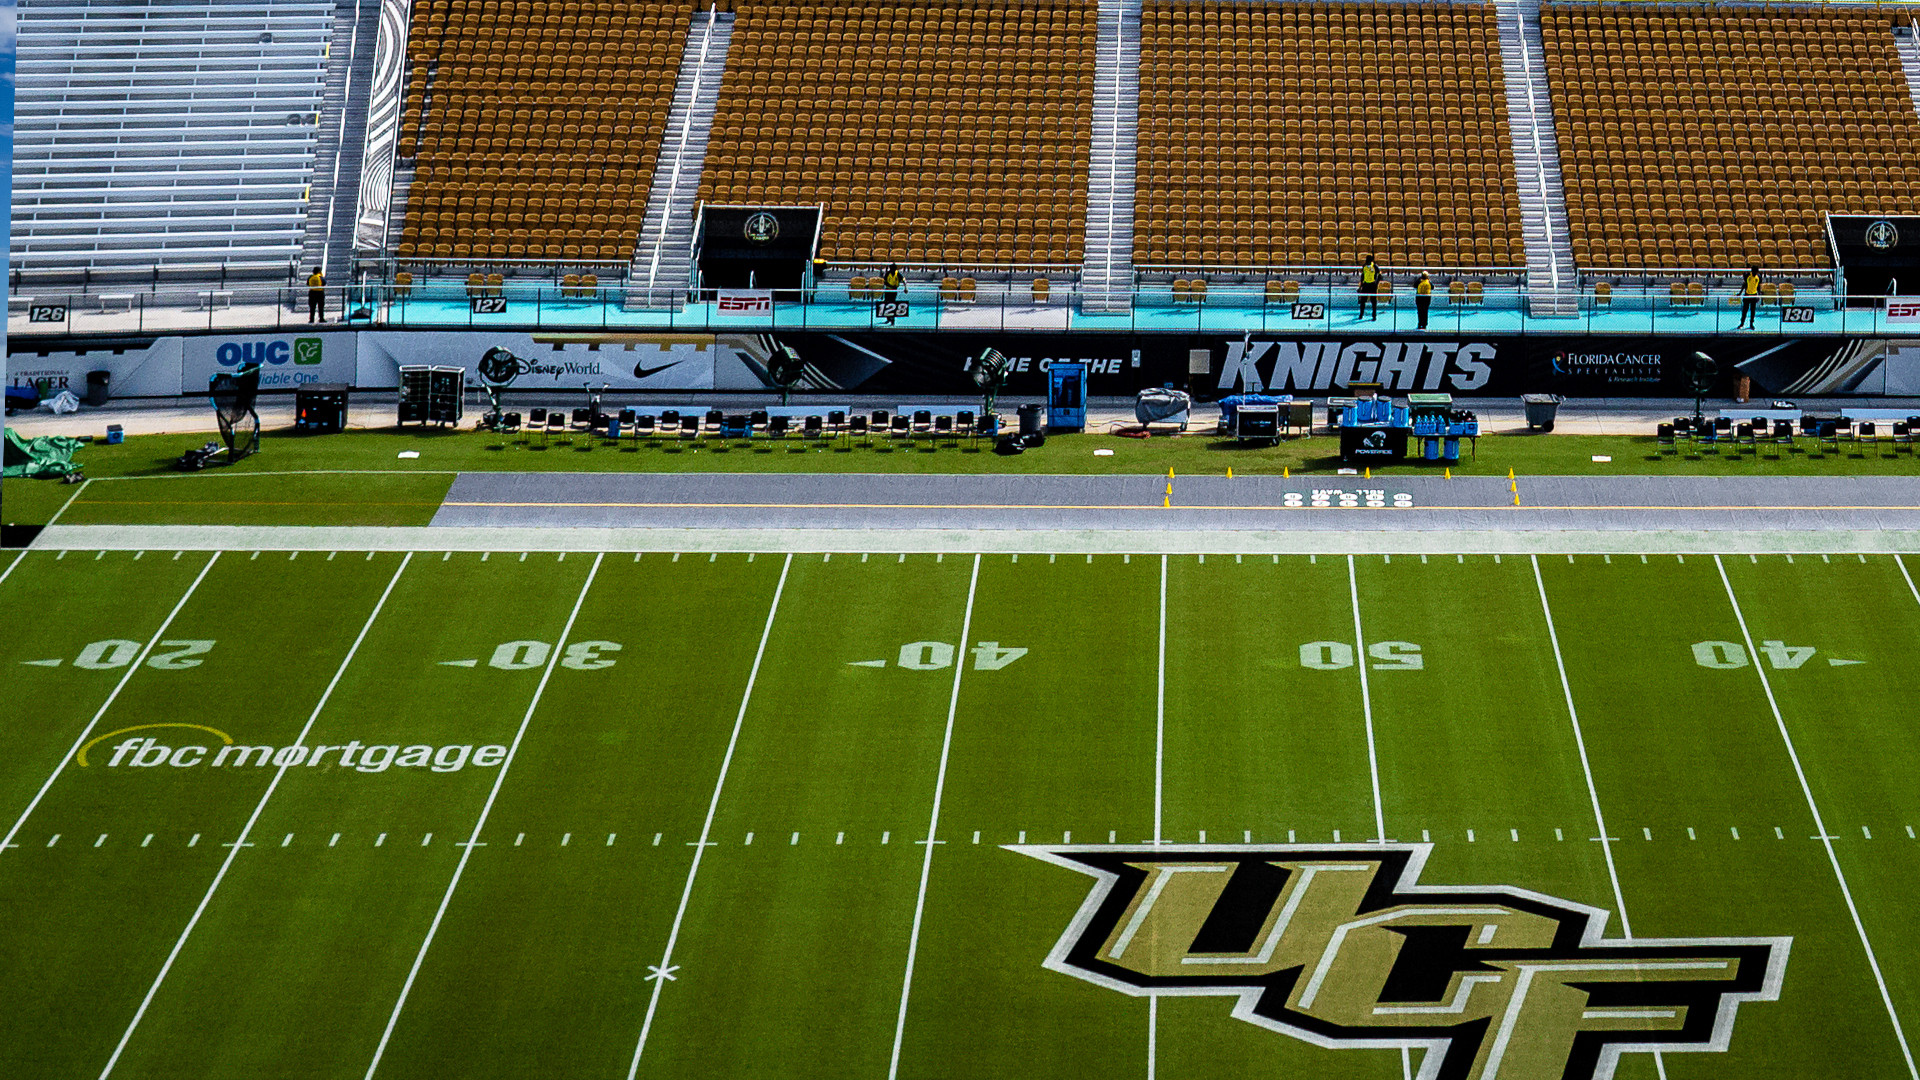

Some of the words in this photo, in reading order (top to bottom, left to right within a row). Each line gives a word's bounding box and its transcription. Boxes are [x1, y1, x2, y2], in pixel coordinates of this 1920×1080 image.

[32, 307, 64, 321] 126
[475, 298, 506, 313] 127
[718, 296, 770, 310] ESPN
[878, 303, 908, 317] 128
[1293, 304, 1324, 318] 129
[1784, 307, 1813, 321] 130
[216, 340, 290, 367] OUC
[1217, 341, 1497, 390] KNIGHTS
[258, 372, 291, 384] liable
[293, 372, 319, 384] One
[563, 362, 600, 375] World
[73, 639, 217, 671] 20
[488, 640, 624, 671] 30
[896, 640, 1029, 672] 40
[1299, 641, 1425, 672] 50
[1690, 640, 1817, 671] 40
[107, 737, 208, 769] fbc
[211, 740, 509, 774] mortgage
[1002, 843, 1793, 1080] UCF
